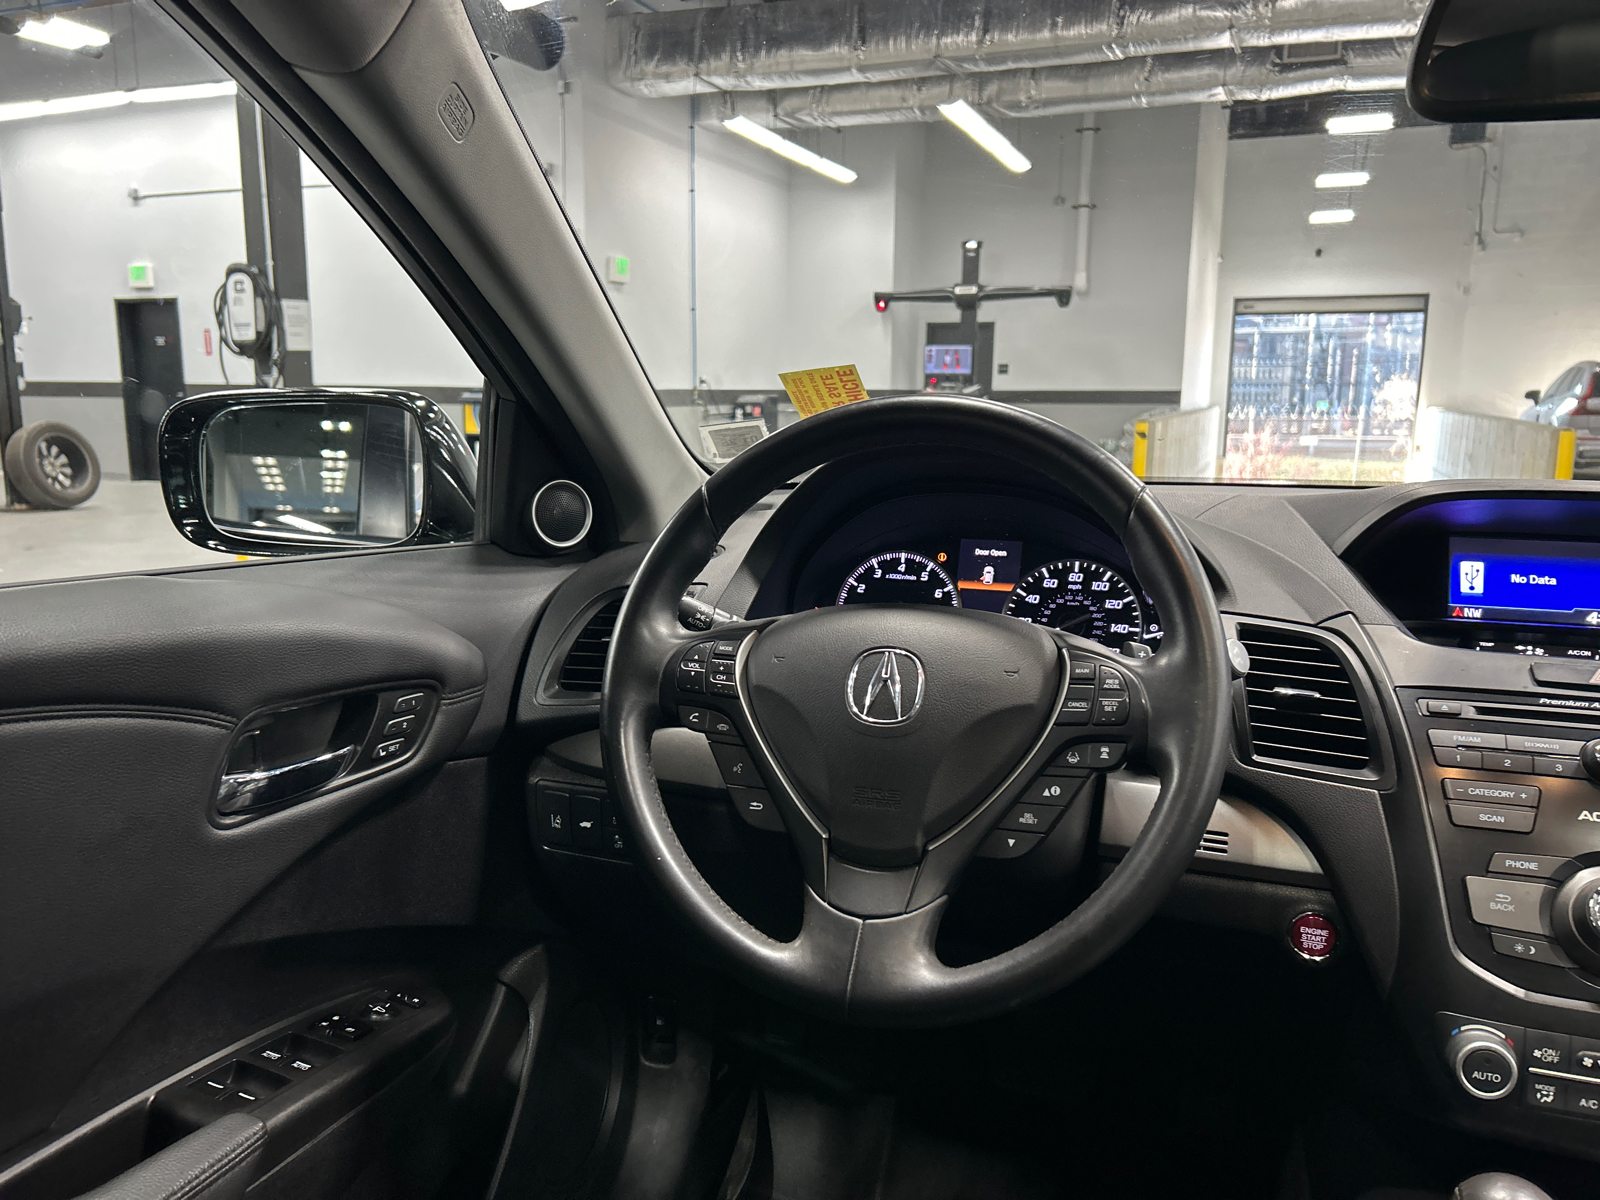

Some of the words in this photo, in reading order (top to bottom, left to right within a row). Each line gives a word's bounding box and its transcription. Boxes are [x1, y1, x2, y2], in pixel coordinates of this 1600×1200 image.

[974, 548, 990, 556] Door
[990, 549, 1007, 558] Open
[898, 564, 906, 572] 4
[873, 569, 882, 578] 3
[920, 572, 929, 581] 5
[1068, 573, 1084, 582] 80
[1043, 579, 1059, 588] 60
[1510, 574, 1527, 583] No
[1529, 575, 1557, 585] Data
[857, 584, 866, 593] 2
[1091, 582, 1110, 591] 100
[934, 588, 943, 599] 6
[1025, 594, 1040, 604] 40
[1105, 599, 1123, 610] 120
[1464, 608, 1482, 618] NW
[1110, 624, 1130, 634] 140
[1538, 698, 1589, 708] Premium
[1453, 735, 1481, 743] FM/AM
[388, 743, 400, 752] SET
[1456, 754, 1461, 762] 1
[1504, 759, 1511, 767] 2
[1555, 764, 1563, 772] 3
[1468, 787, 1515, 798] CATEGORY
[1019, 817, 1038, 825] RESET
[1479, 813, 1505, 823] SCAN
[1505, 859, 1539, 871] PHONE
[1489, 902, 1515, 912] BACK
[1300, 926, 1330, 937] ENGINE
[1301, 934, 1327, 943] START
[1302, 942, 1324, 950] STOP
[1541, 1055, 1560, 1064] OFF
[1472, 1070, 1502, 1083] AUTO
[1534, 1083, 1556, 1093] MODE
[1578, 1098, 1599, 1110] A/C
